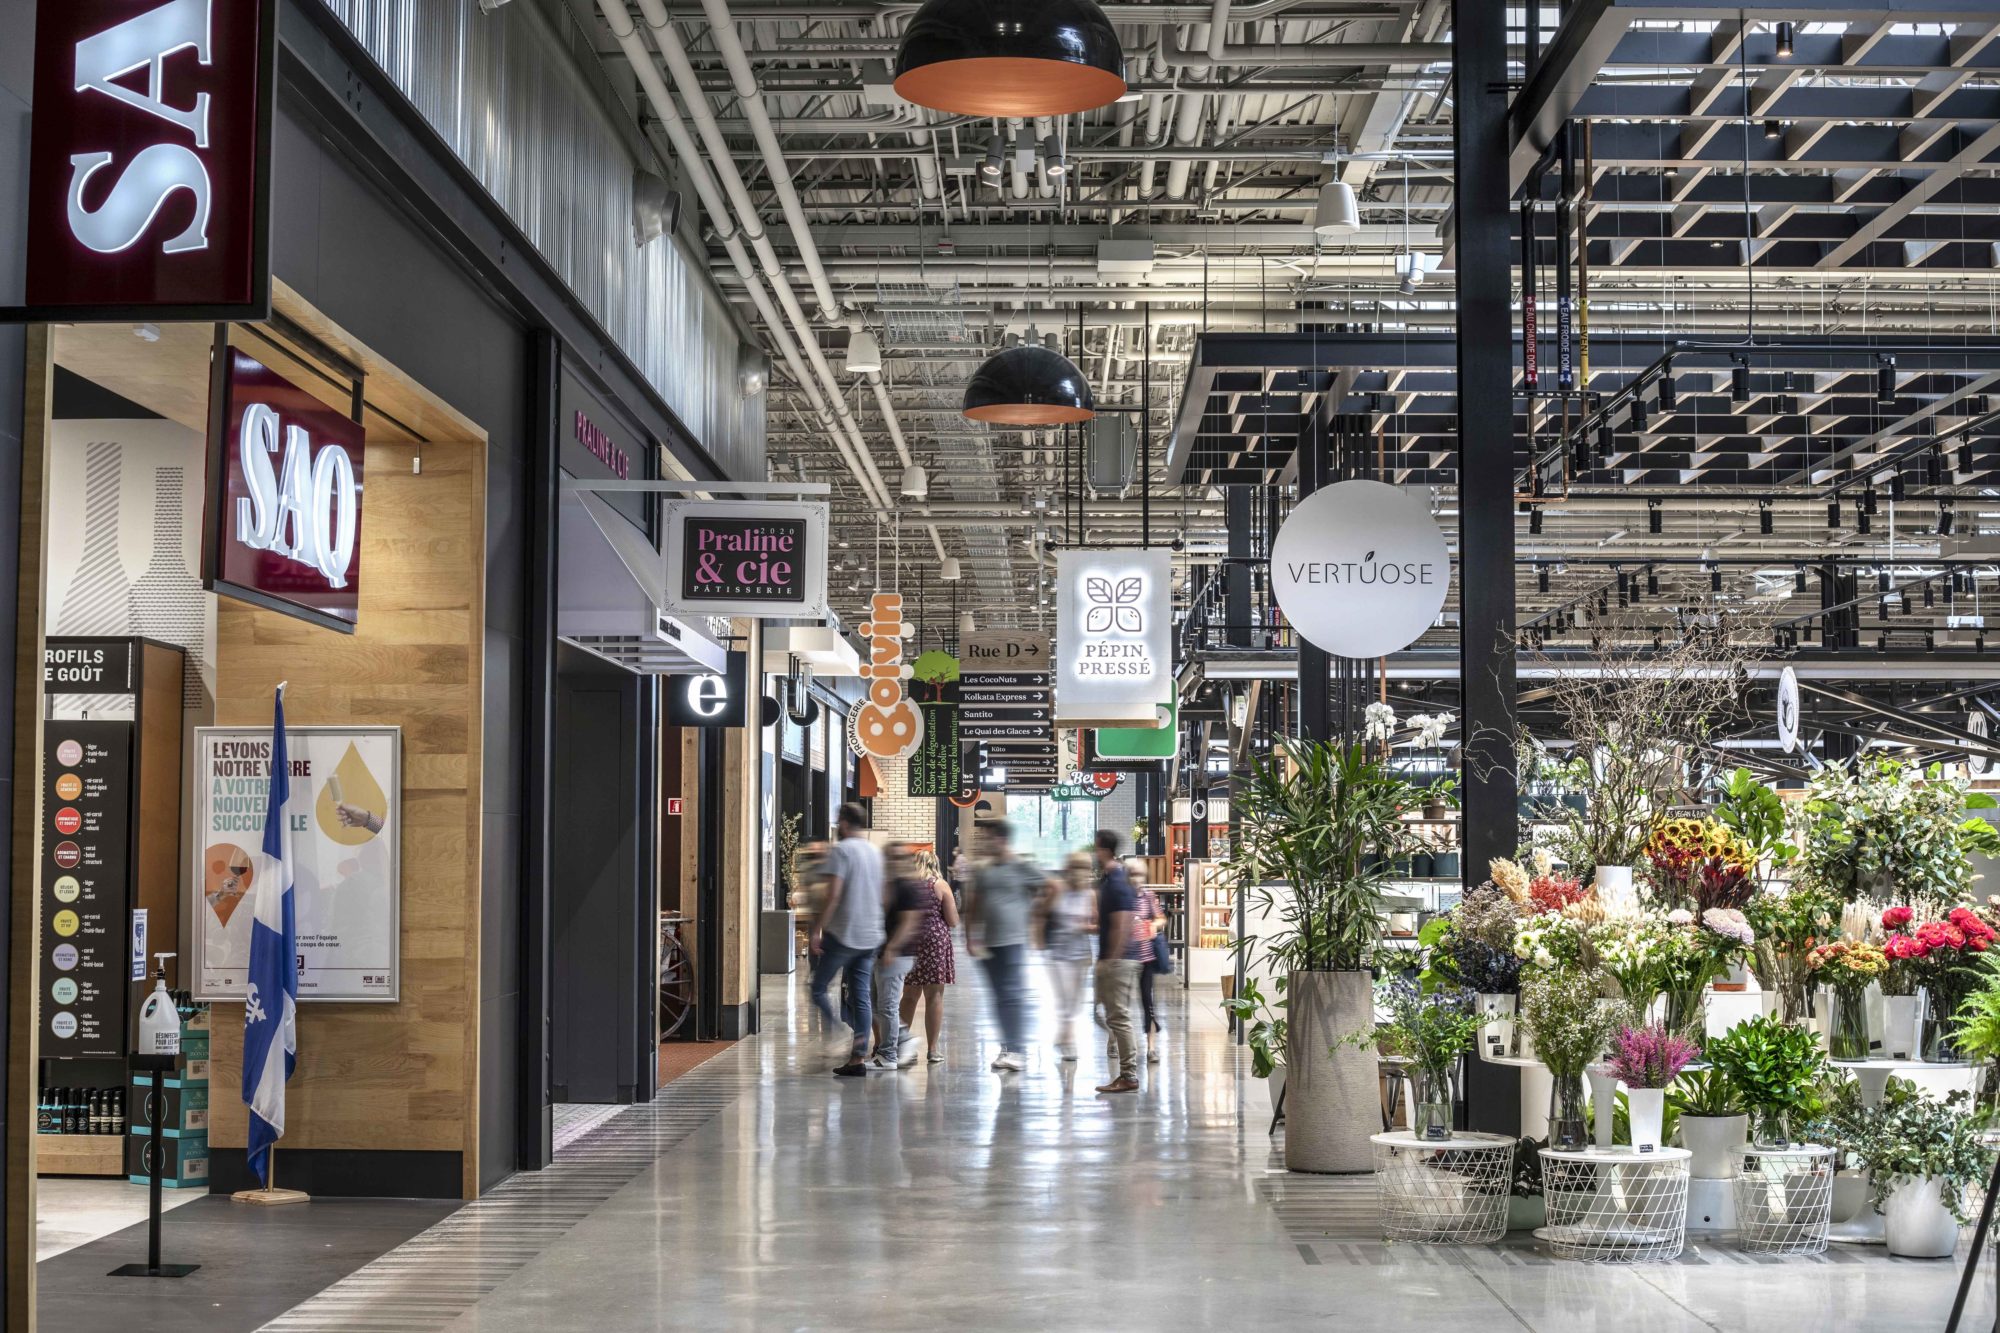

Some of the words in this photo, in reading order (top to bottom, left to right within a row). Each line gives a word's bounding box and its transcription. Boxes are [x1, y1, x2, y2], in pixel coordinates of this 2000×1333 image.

[68, 0, 212, 254] SA
[1526, 308, 1534, 322] EAU
[1560, 308, 1568, 323] EAU
[1526, 324, 1535, 354] CHAUDE
[1561, 325, 1569, 352] FROIDE
[576, 410, 609, 465] PRALINE
[236, 403, 357, 589] SAQ
[698, 528, 794, 552] Praline
[696, 552, 725, 584] &
[736, 552, 792, 584] cie
[1288, 559, 1433, 584] VERTUOSE
[693, 585, 792, 594] PÂTISSERIE
[45, 649, 104, 664] ROFILS
[968, 644, 1000, 658] Rue
[1006, 643, 1020, 658] D
[1086, 641, 1144, 658] PÉPIN
[44, 668, 54, 681] E
[58, 664, 104, 682] GOÛT
[1078, 658, 1151, 675] PRESSÉ
[996, 693, 1027, 702] Express
[848, 698, 867, 756] FROMAGERIE
[926, 709, 938, 757] dégustation
[948, 710, 958, 757] balsamique
[213, 742, 270, 759] LEVONS
[213, 760, 262, 776] NOTRE
[926, 760, 936, 768] de
[912, 767, 922, 794] Sous
[926, 768, 936, 794] Salon
[937, 771, 947, 794] Huile
[949, 758, 960, 794] Vinaigre
[213, 796, 267, 813] NOUVEL
[213, 814, 308, 832] SUCCULE
